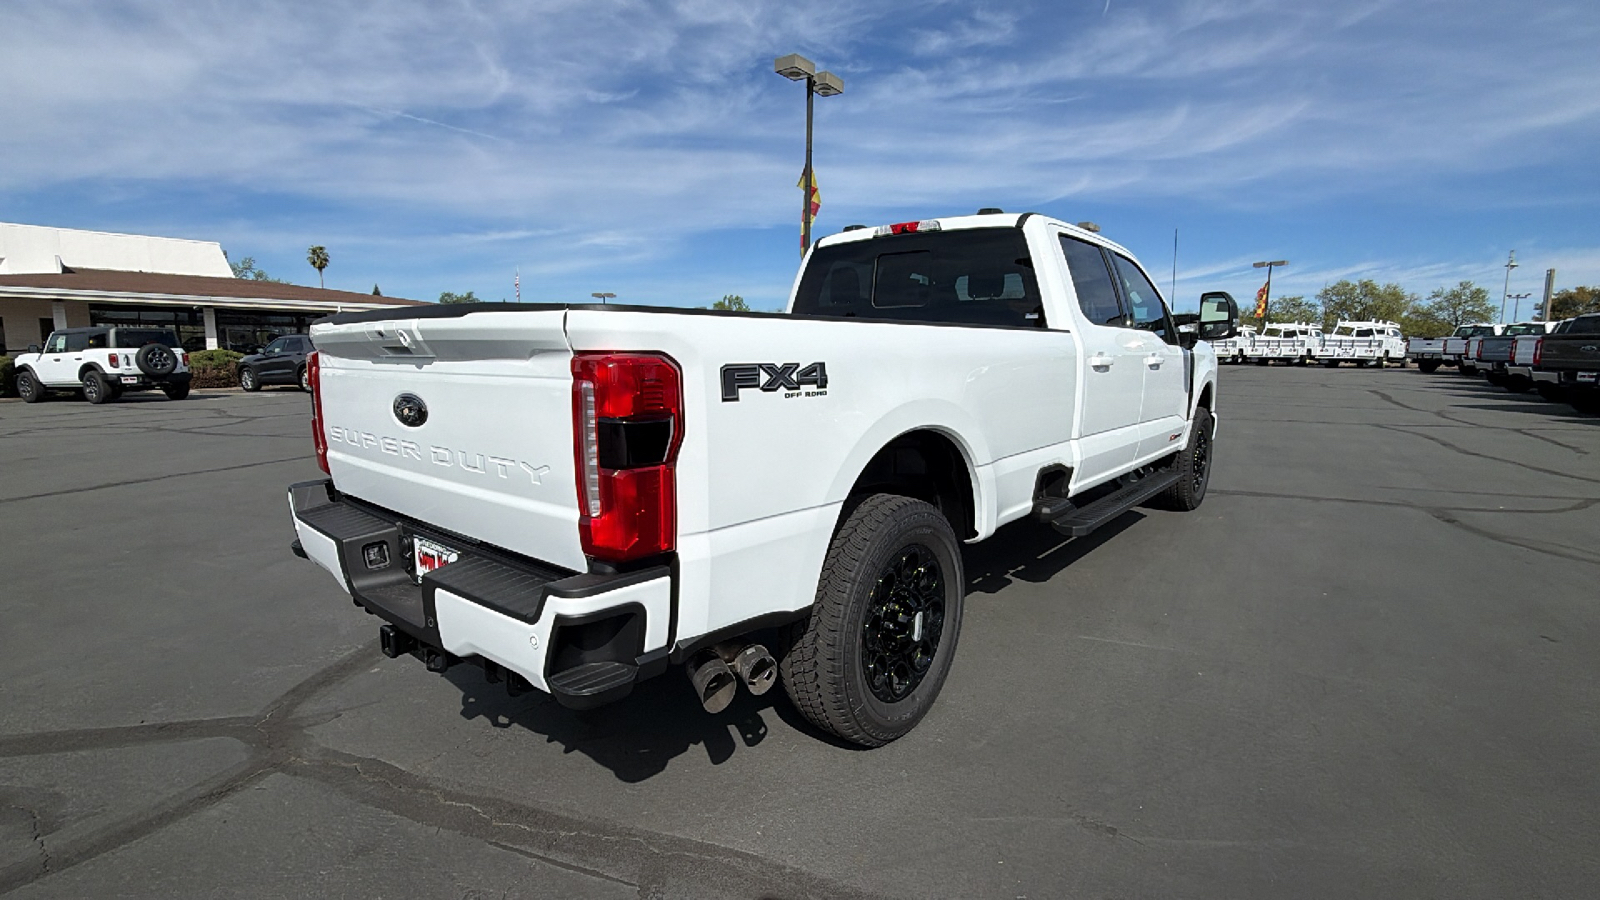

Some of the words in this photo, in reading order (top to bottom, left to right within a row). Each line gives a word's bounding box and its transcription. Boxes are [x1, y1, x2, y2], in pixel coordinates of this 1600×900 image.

[720, 362, 828, 402] FX4
[784, 391, 802, 399] OFF
[804, 390, 828, 398] ROAD
[330, 426, 422, 461] SUPER
[430, 445, 551, 486] DUTY
